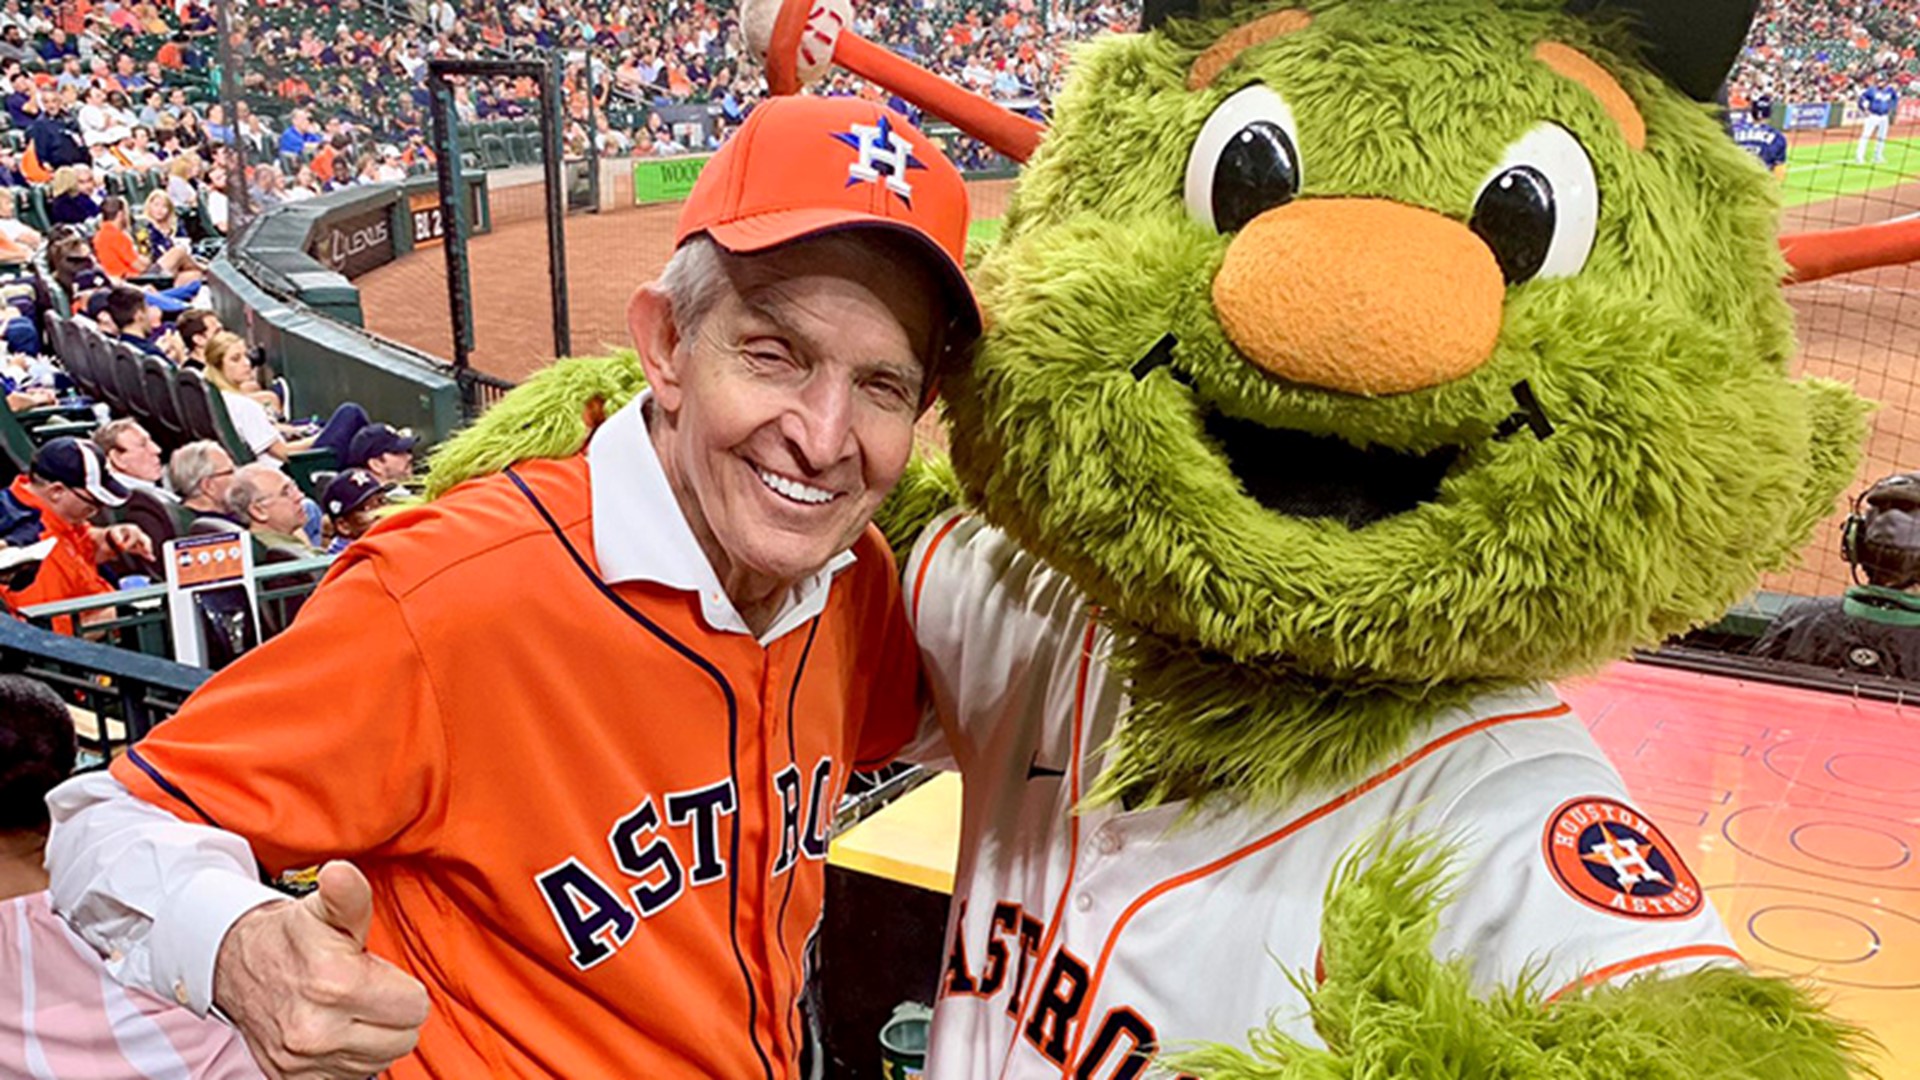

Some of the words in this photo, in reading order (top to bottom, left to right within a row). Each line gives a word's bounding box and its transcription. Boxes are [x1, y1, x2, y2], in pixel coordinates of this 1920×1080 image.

[849, 123, 913, 196] H
[1555, 804, 1650, 849] HOUSTON
[1591, 838, 1664, 884] H
[1610, 882, 1697, 914] ASTROS
[940, 895, 1200, 1080] ASTRO
